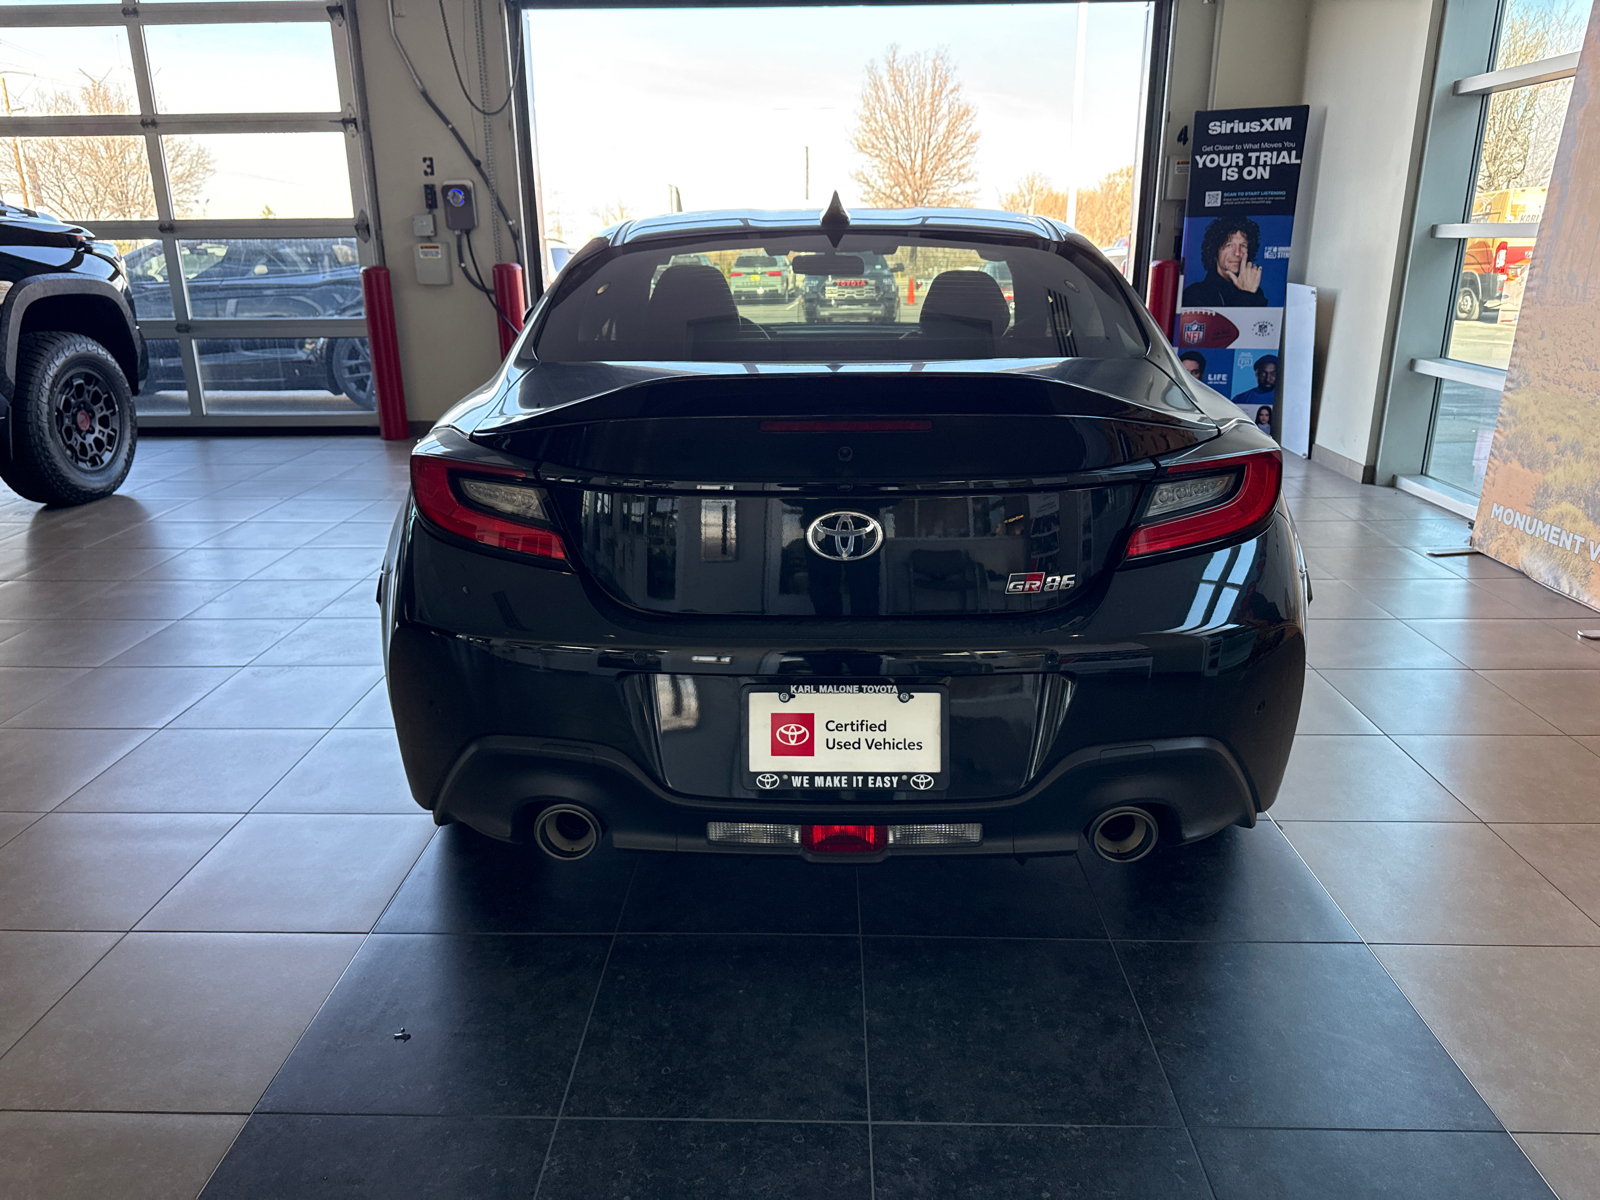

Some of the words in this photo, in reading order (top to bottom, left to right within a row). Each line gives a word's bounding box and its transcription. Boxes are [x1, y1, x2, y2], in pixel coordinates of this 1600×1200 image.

[1208, 117, 1292, 135] SiriusXM
[1176, 125, 1189, 146] 4
[1214, 143, 1234, 151] Closer
[1243, 142, 1260, 150] What
[1261, 141, 1282, 149] Moves
[1195, 153, 1244, 169] YOUR
[1248, 150, 1301, 166] TRIAL
[422, 157, 435, 176] 3
[1221, 167, 1239, 181] IS
[1242, 166, 1270, 180] ON
[1185, 331, 1204, 342] NFL
[1490, 502, 1586, 555] MONUMENT
[1588, 541, 1600, 564] V
[790, 685, 816, 694] KARL
[819, 685, 860, 694] MALONE
[862, 685, 898, 694] TOYOTA
[825, 720, 887, 732] Certified
[826, 738, 861, 750] Used
[865, 738, 923, 750] Vehicles
[792, 776, 810, 787] WE
[814, 776, 848, 787] MAKE
[853, 776, 863, 787] IT
[868, 776, 899, 788] EASY
